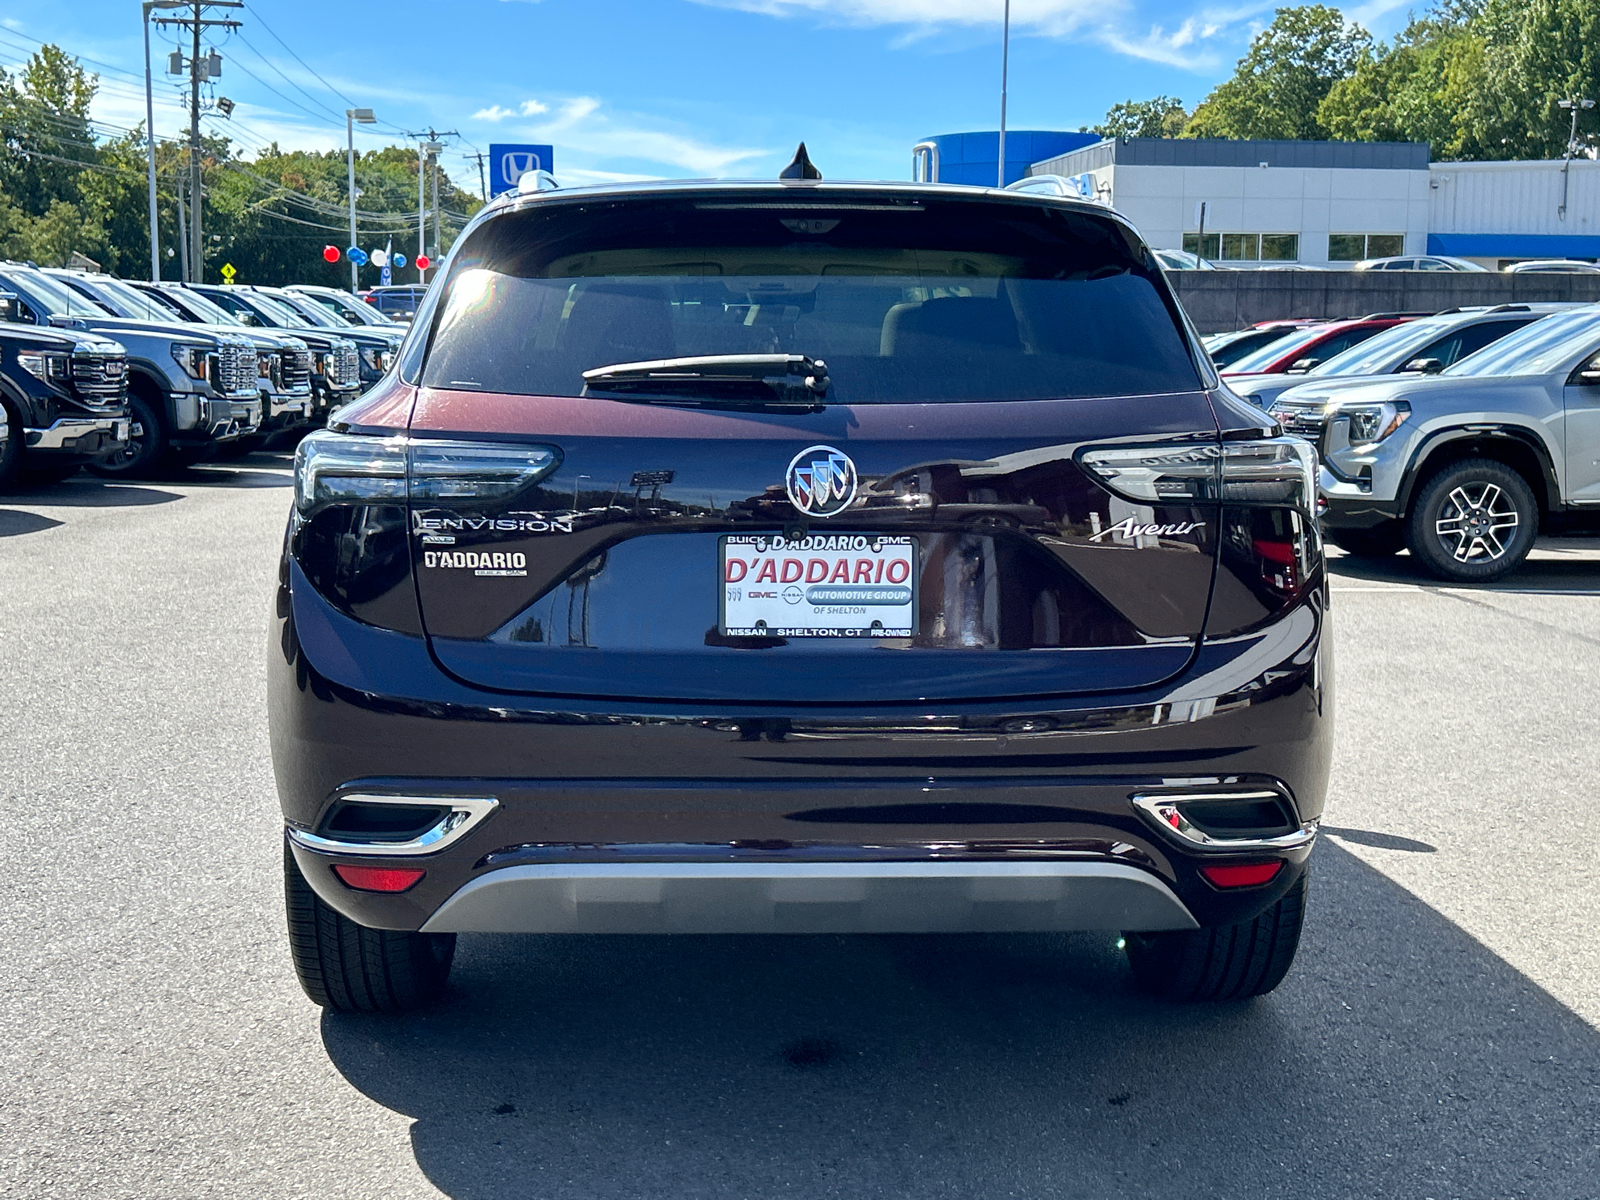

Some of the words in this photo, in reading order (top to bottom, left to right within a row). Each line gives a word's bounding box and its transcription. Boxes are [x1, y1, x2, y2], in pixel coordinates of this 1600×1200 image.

[422, 518, 573, 533] ENVISION
[1088, 517, 1206, 540] Avenir
[727, 536, 766, 544] BUICK
[772, 536, 867, 550] D'ADDARIO
[877, 536, 911, 544] GMC
[425, 551, 526, 569] D'ADDARIO
[725, 558, 910, 584] D'ADDARIO
[748, 591, 778, 599] GMC
[812, 591, 874, 600] AUTOMOTIVE
[875, 591, 907, 600] GROUP
[813, 606, 825, 615] OF
[827, 606, 867, 615] SHELTON
[845, 628, 863, 636] CT
